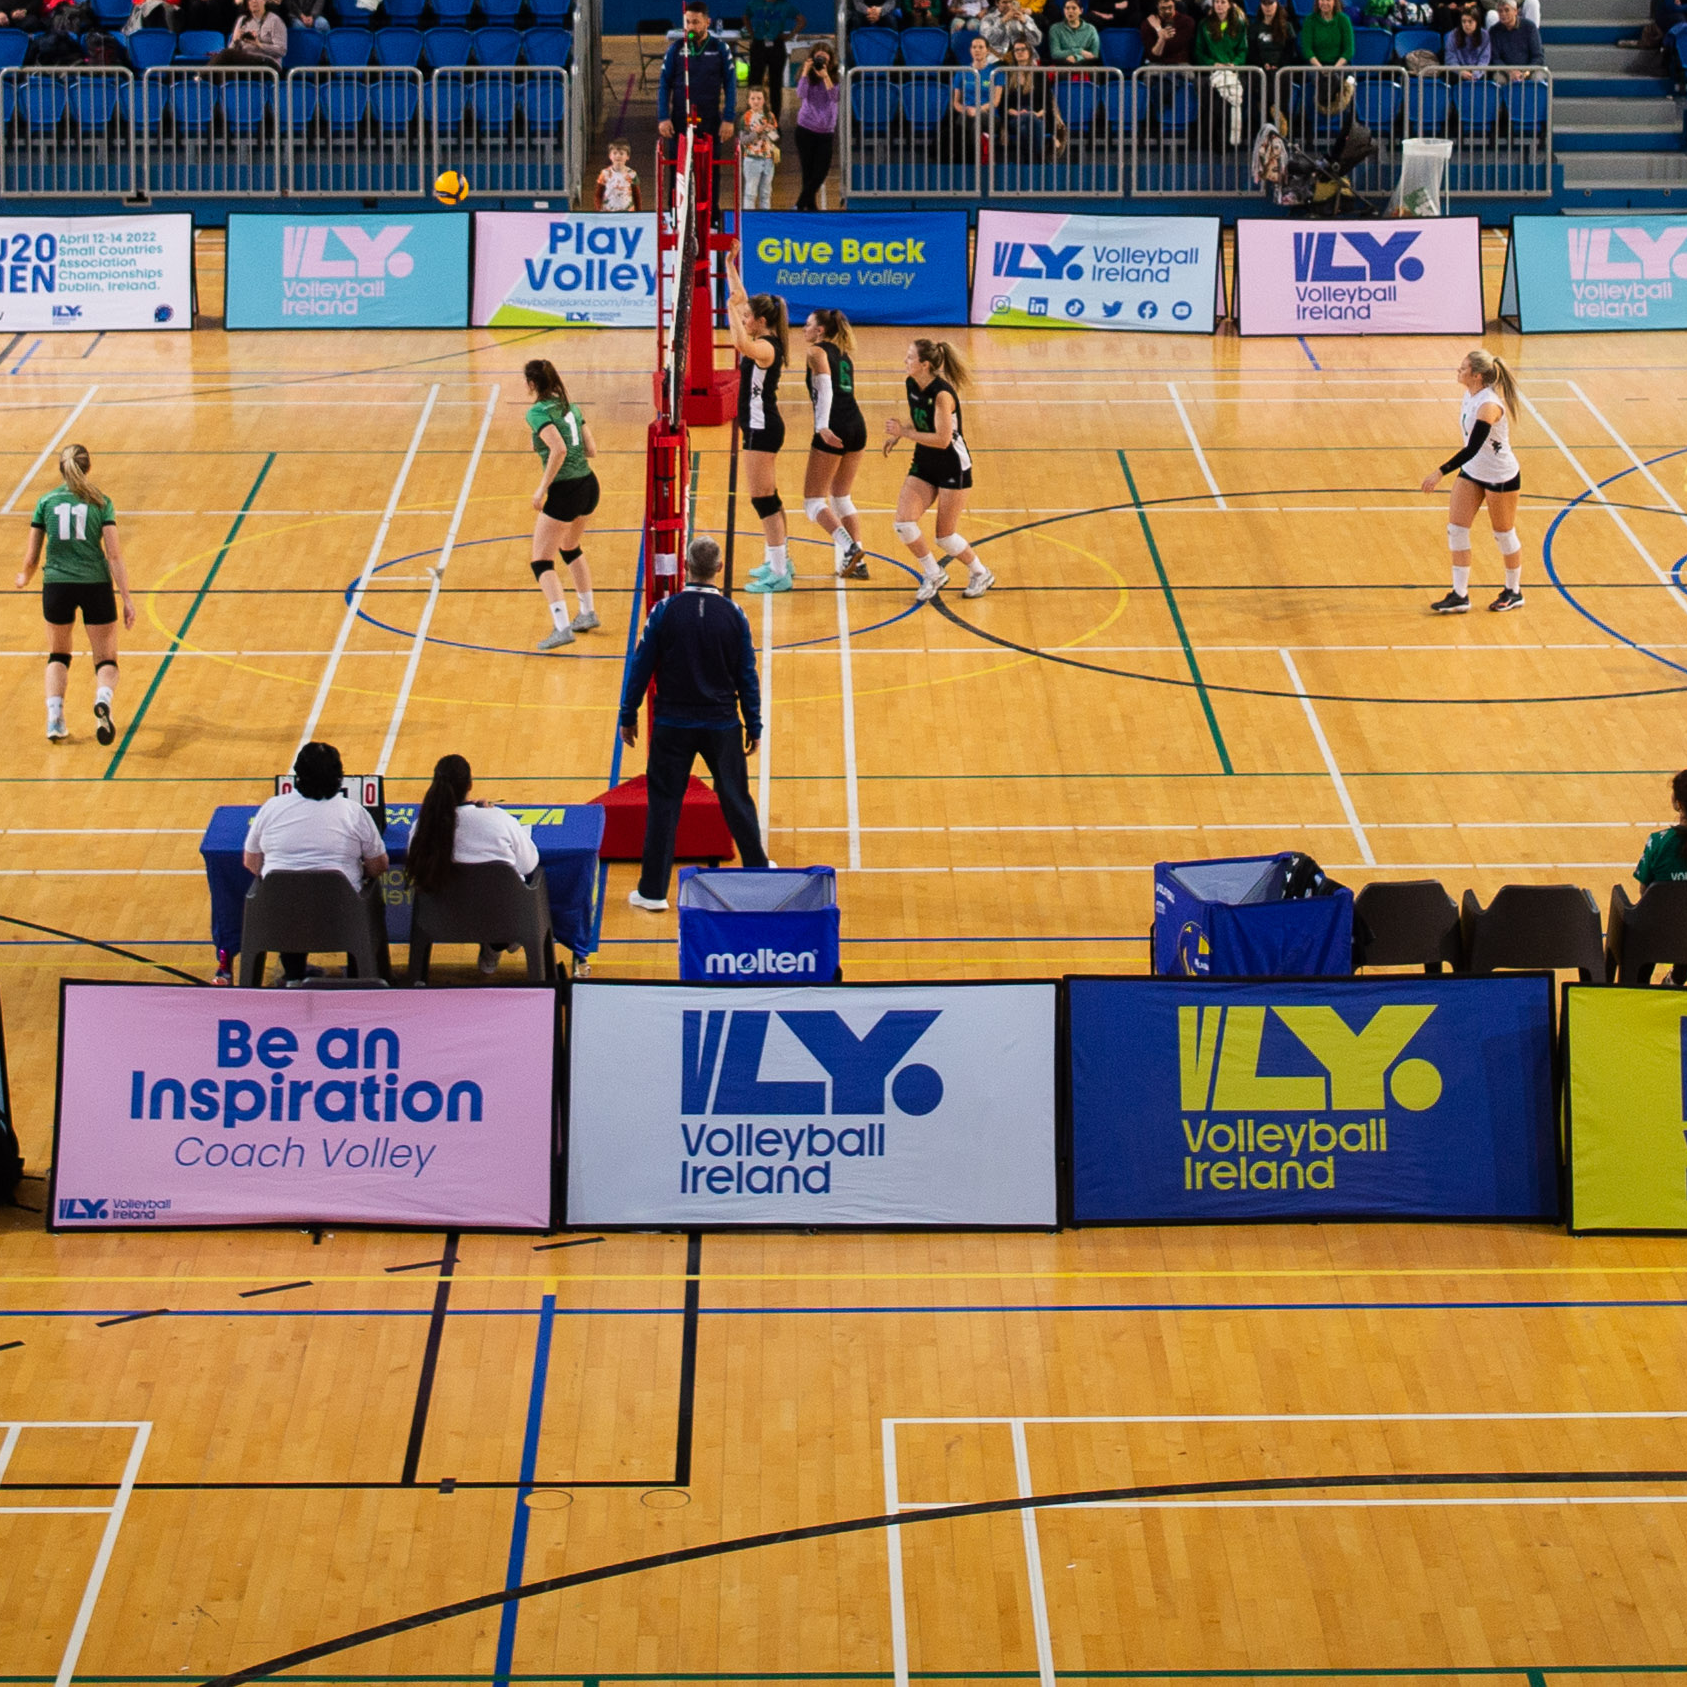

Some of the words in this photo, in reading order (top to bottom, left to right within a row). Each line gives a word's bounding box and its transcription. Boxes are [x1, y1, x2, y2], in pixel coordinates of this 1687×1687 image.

[59, 233, 89, 246] April
[93, 232, 122, 243] 12-14
[126, 232, 156, 242] 2022
[59, 245, 95, 256] Small
[99, 243, 163, 255] Countries
[549, 222, 644, 259] Play
[757, 237, 834, 264] Give
[841, 237, 926, 264] Back
[59, 257, 137, 268] Association
[1093, 245, 1199, 268] Volleyball
[59, 268, 163, 281] Championships
[524, 258, 658, 296] Volley
[776, 268, 851, 286] Referee
[857, 268, 916, 291] Volley
[1092, 264, 1170, 283] Ireland
[108, 281, 161, 292] Ireland.
[283, 280, 385, 300] Volleyball
[1296, 285, 1397, 307] Volleyball
[1572, 281, 1673, 301] Volleyball
[283, 297, 359, 315] Ireland
[1297, 303, 1371, 320] Ireland
[1574, 298, 1648, 317] Ireland
[54, 502, 88, 541] 11
[365, 782, 376, 805] 0
[706, 947, 818, 975] molten
[217, 1019, 299, 1069] Be
[317, 1026, 399, 1069] an
[130, 1070, 483, 1129] Inspiration
[681, 1119, 885, 1164] Volleyball
[1182, 1117, 1387, 1161] Volleyball
[175, 1136, 305, 1169] Coach
[324, 1136, 436, 1178] Volley
[680, 1159, 831, 1194] Ireland
[1183, 1156, 1335, 1190] Ireland
[112, 1198, 171, 1212] Volleyball
[112, 1208, 156, 1220] Ireland
